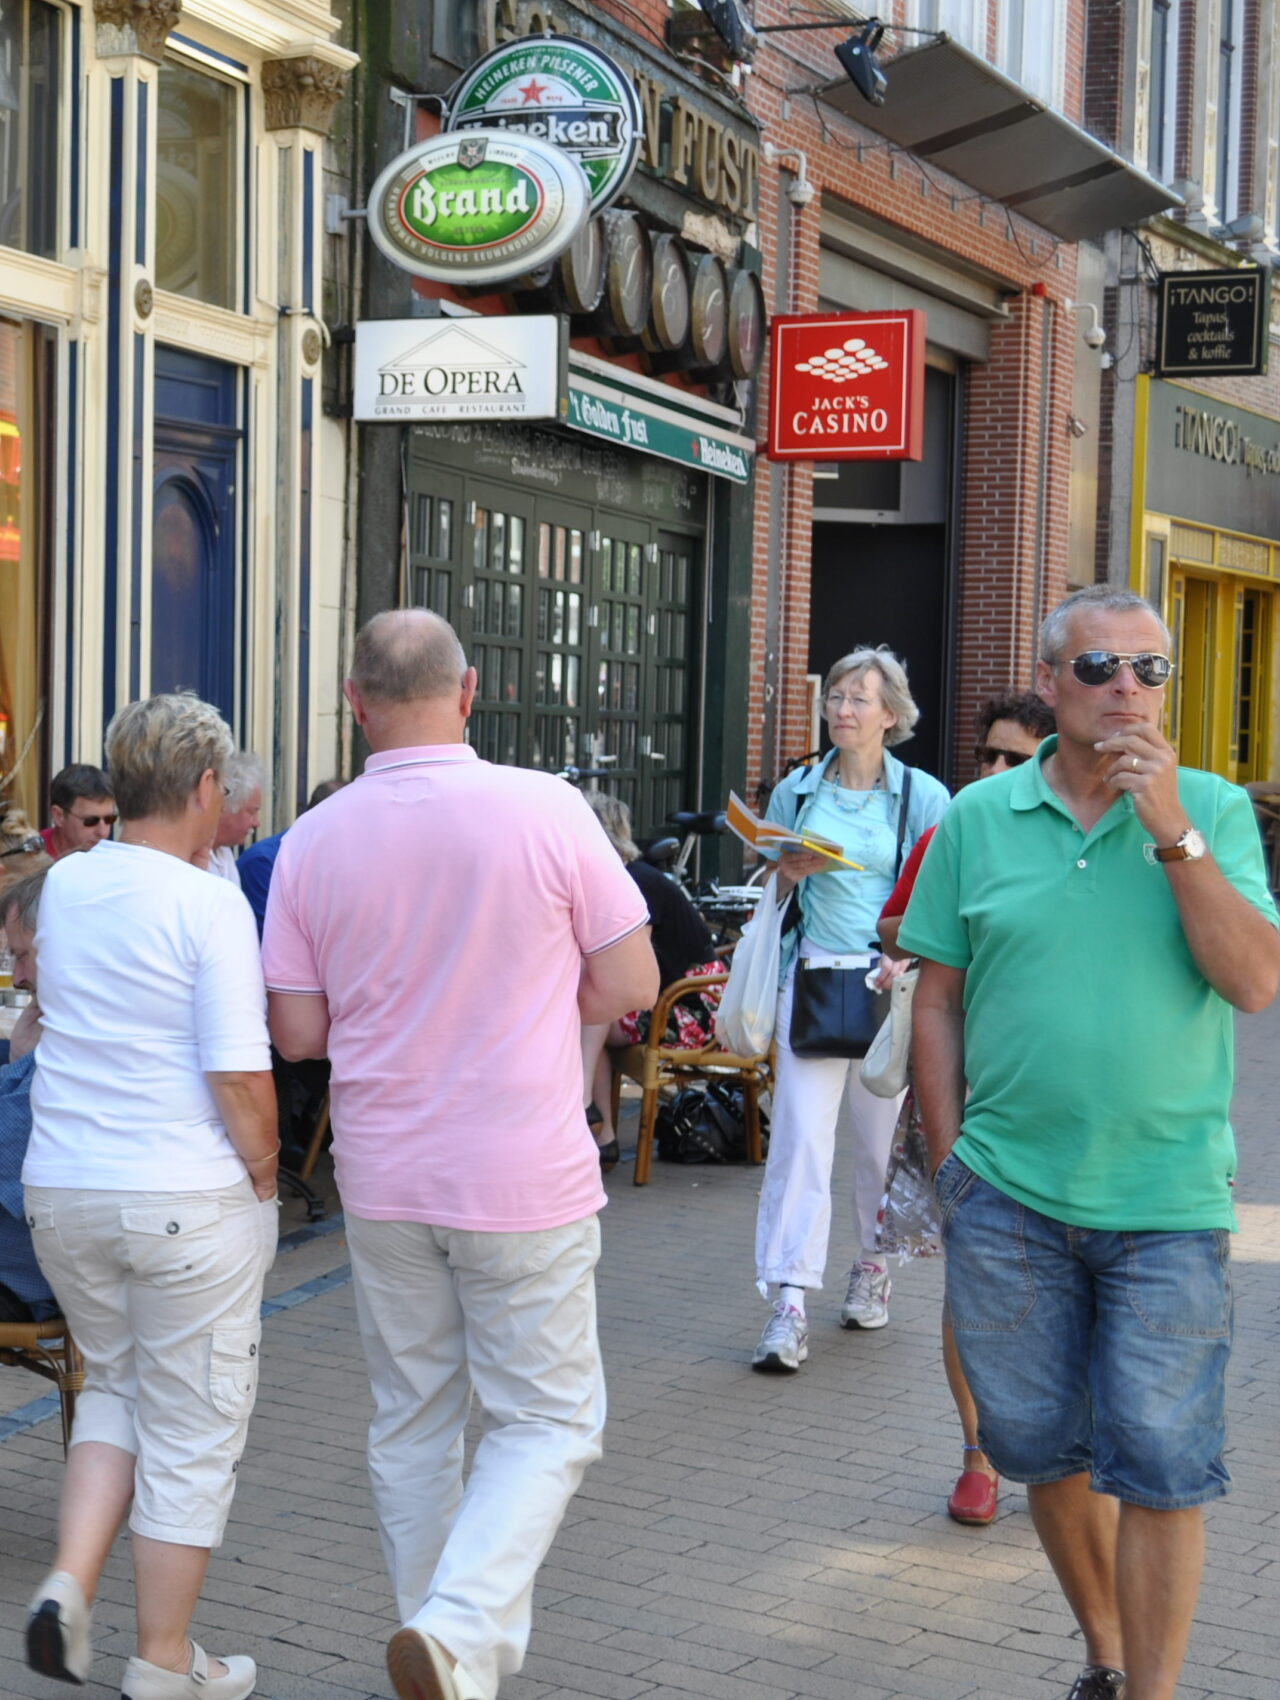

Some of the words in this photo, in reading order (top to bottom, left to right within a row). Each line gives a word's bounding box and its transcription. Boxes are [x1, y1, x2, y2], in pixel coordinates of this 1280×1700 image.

[474, 54, 537, 100] HEINEKEN
[540, 55, 600, 93] PILSENER
[463, 113, 610, 144] eken
[673, 96, 760, 223] FUST
[413, 177, 530, 227] Brand
[421, 244, 469, 263] VOLGENS
[1188, 347, 1199, 360] &
[1201, 343, 1232, 360] koffie
[378, 372, 416, 396] DE
[423, 367, 524, 396] OPERA
[374, 405, 412, 415] GRAND
[422, 404, 447, 414] CAFE
[458, 403, 526, 414] RESTAURANT
[811, 395, 870, 411] JACK'S
[792, 408, 889, 436] CASINO
[698, 436, 748, 477] Heineken
